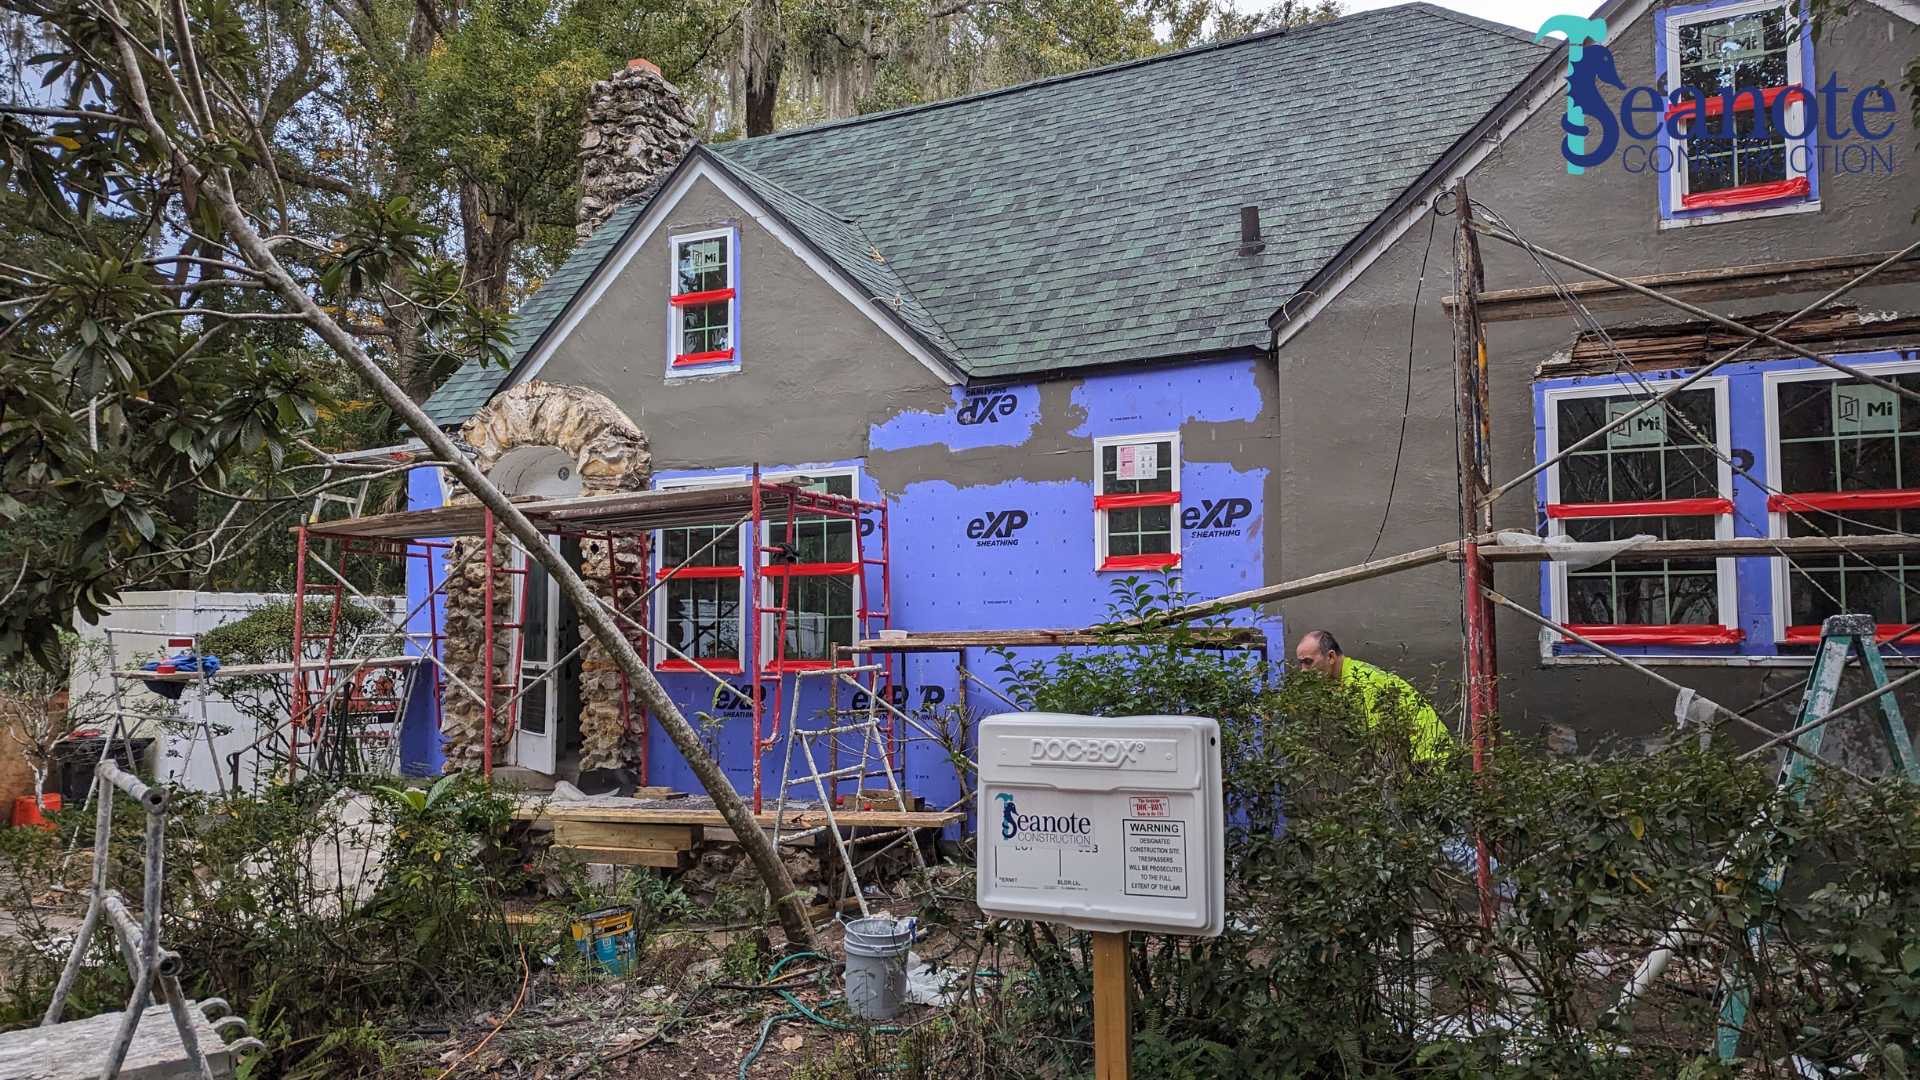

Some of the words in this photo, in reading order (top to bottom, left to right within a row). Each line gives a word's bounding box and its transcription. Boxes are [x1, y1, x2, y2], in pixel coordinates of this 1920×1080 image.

[704, 252, 717, 264] Mi
[956, 394, 1018, 425] eXP
[1867, 402, 1893, 417] Mi
[1637, 416, 1660, 431] Mi
[1180, 497, 1253, 529] eXP
[966, 509, 1029, 539] eXP
[1191, 529, 1241, 539] SHEATHING
[976, 539, 1019, 547] SHEATHING
[1130, 823, 1179, 833] WARNING
[1018, 831, 1092, 846] CONSTRUCTION
[1130, 846, 1168, 854] CONSTRUCTION
